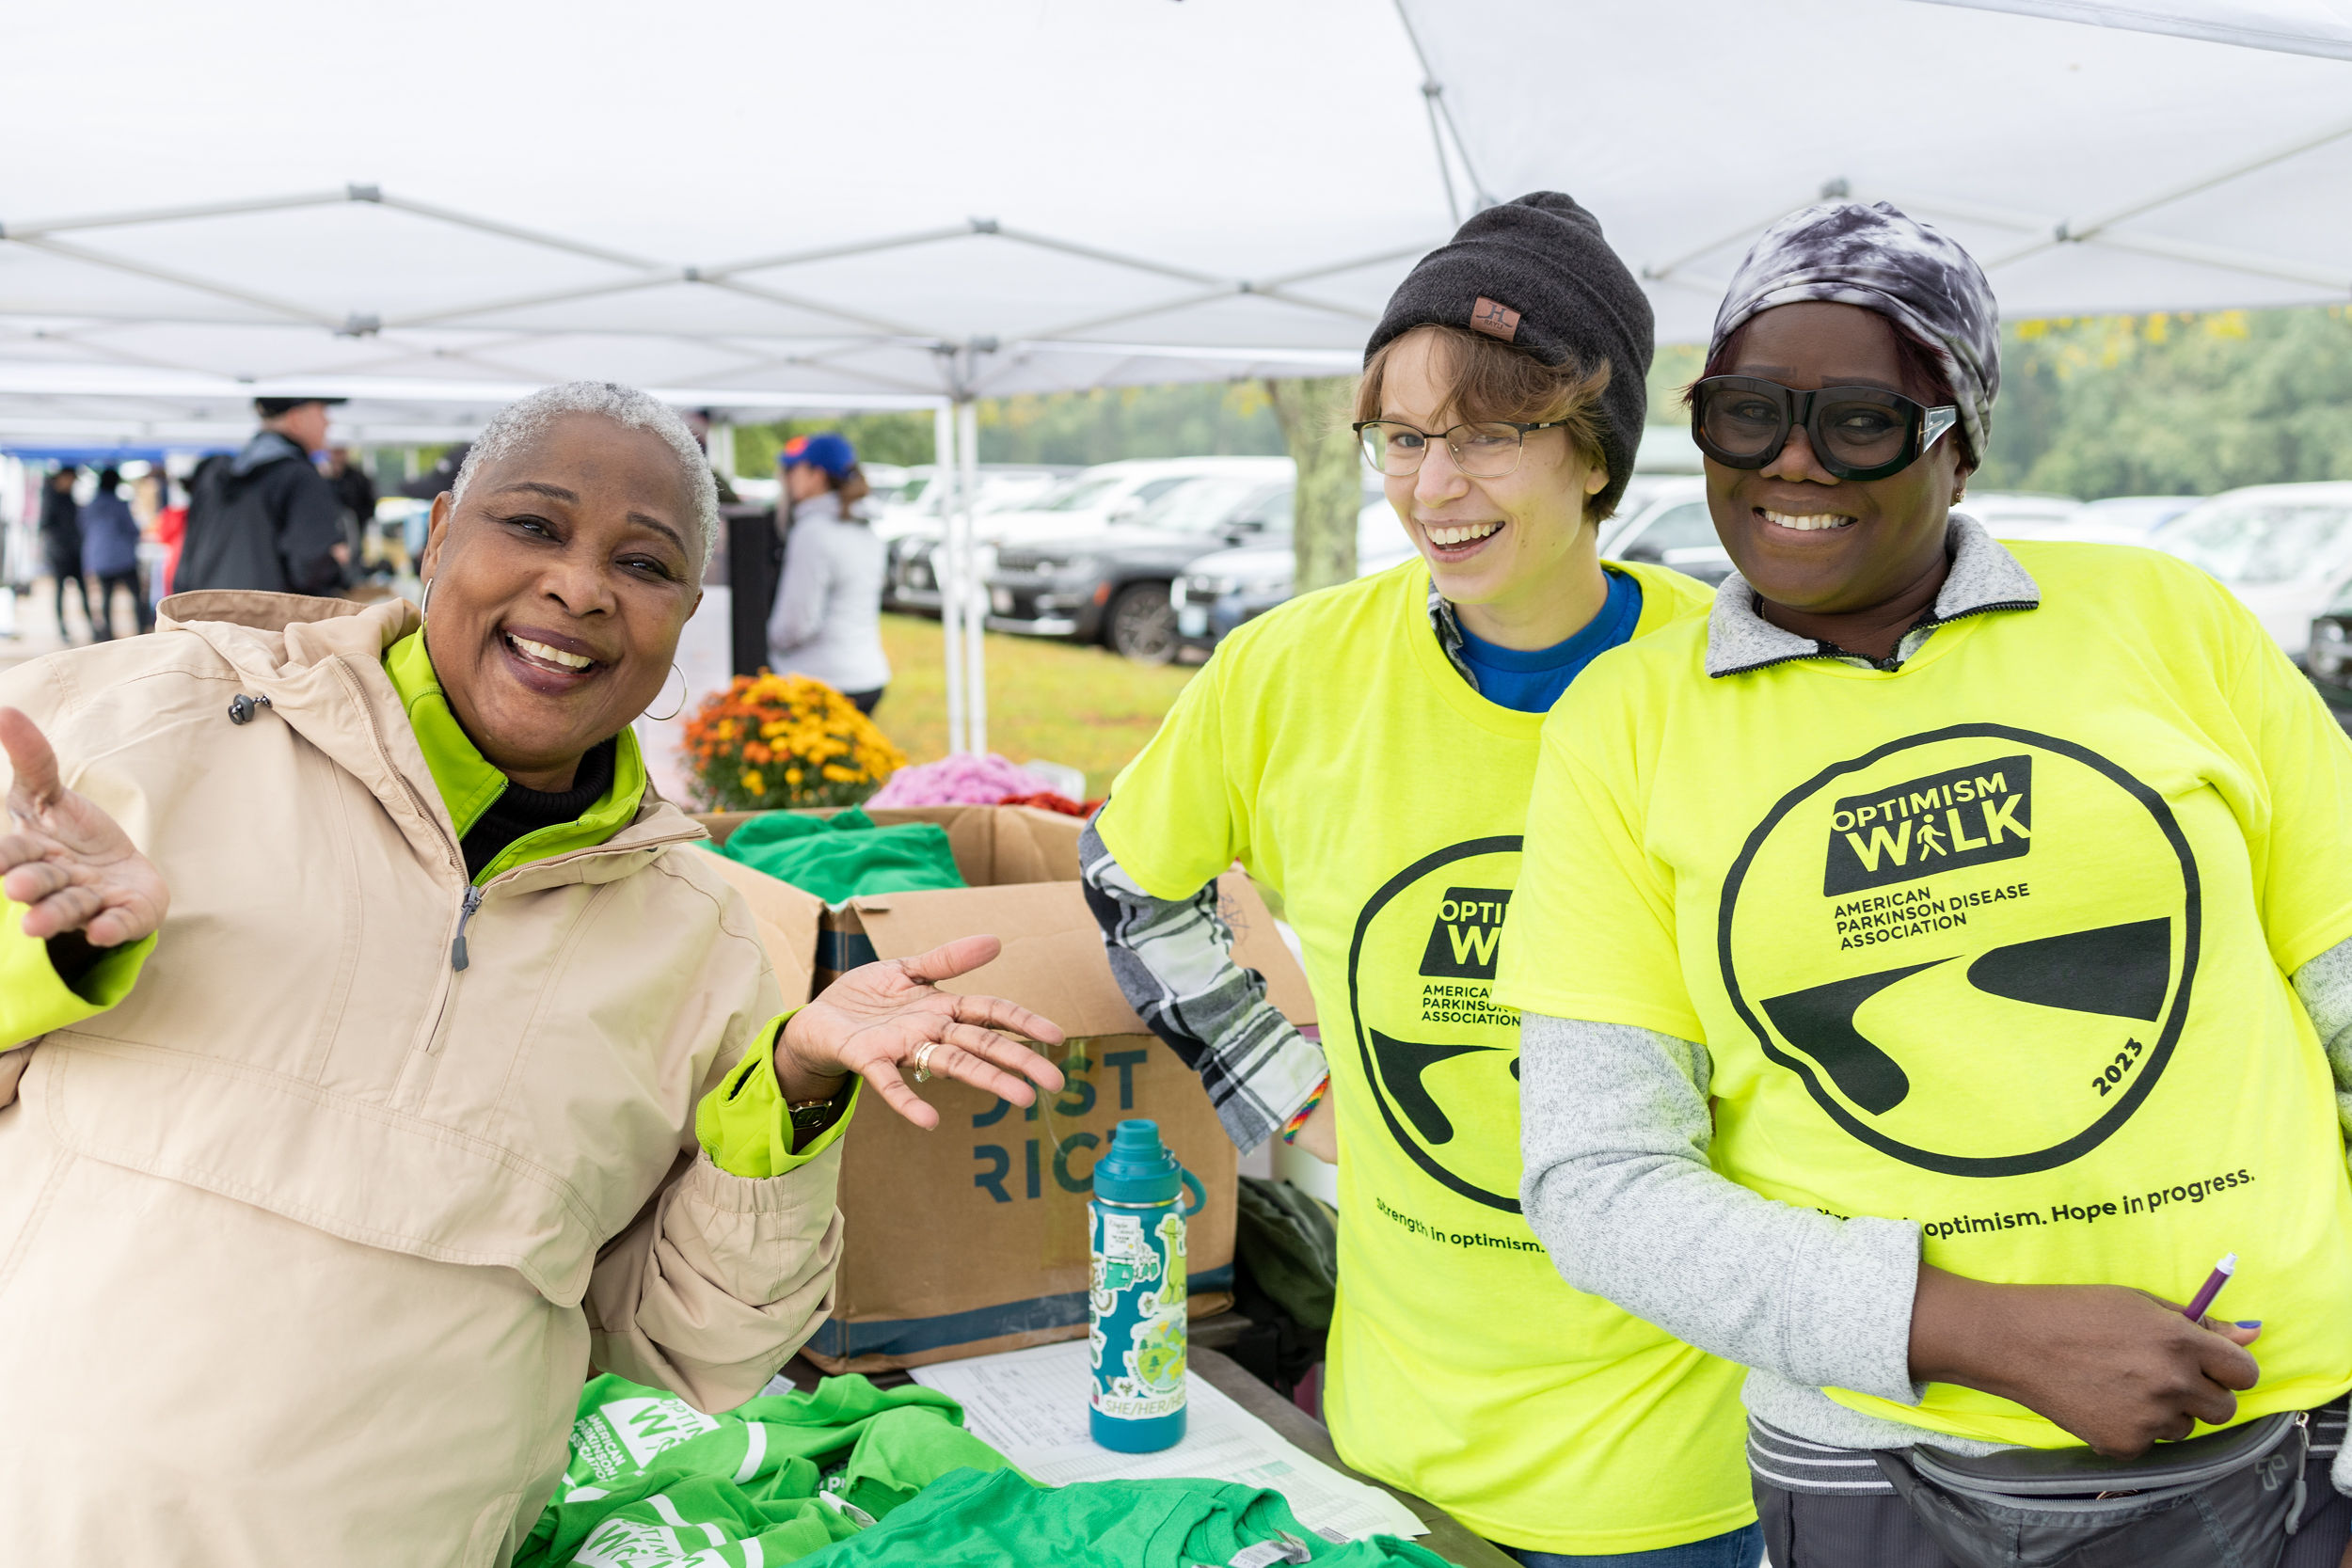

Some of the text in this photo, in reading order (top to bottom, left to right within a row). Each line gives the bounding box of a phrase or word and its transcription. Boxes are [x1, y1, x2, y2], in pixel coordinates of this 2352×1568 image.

[1830, 771, 2009, 832] OPTIMISM
[1438, 899, 1508, 925] OPTI
[1834, 886, 1931, 919] AMERICAN
[1836, 882, 2030, 935] PARKINSON DISEASE
[1840, 911, 1967, 951] ASSOCIATION
[1422, 984, 1493, 999] AMERICA
[1422, 997, 1508, 1013] PARKINSO
[1422, 1010, 1521, 1027] ASSOCIATION
[2091, 1037, 2143, 1097] 2023
[973, 1130, 1117, 1204] RIC
[1376, 1196, 1546, 1254] Strength in optimism.
[1924, 1168, 2256, 1240] optimism. Hope in progress.
